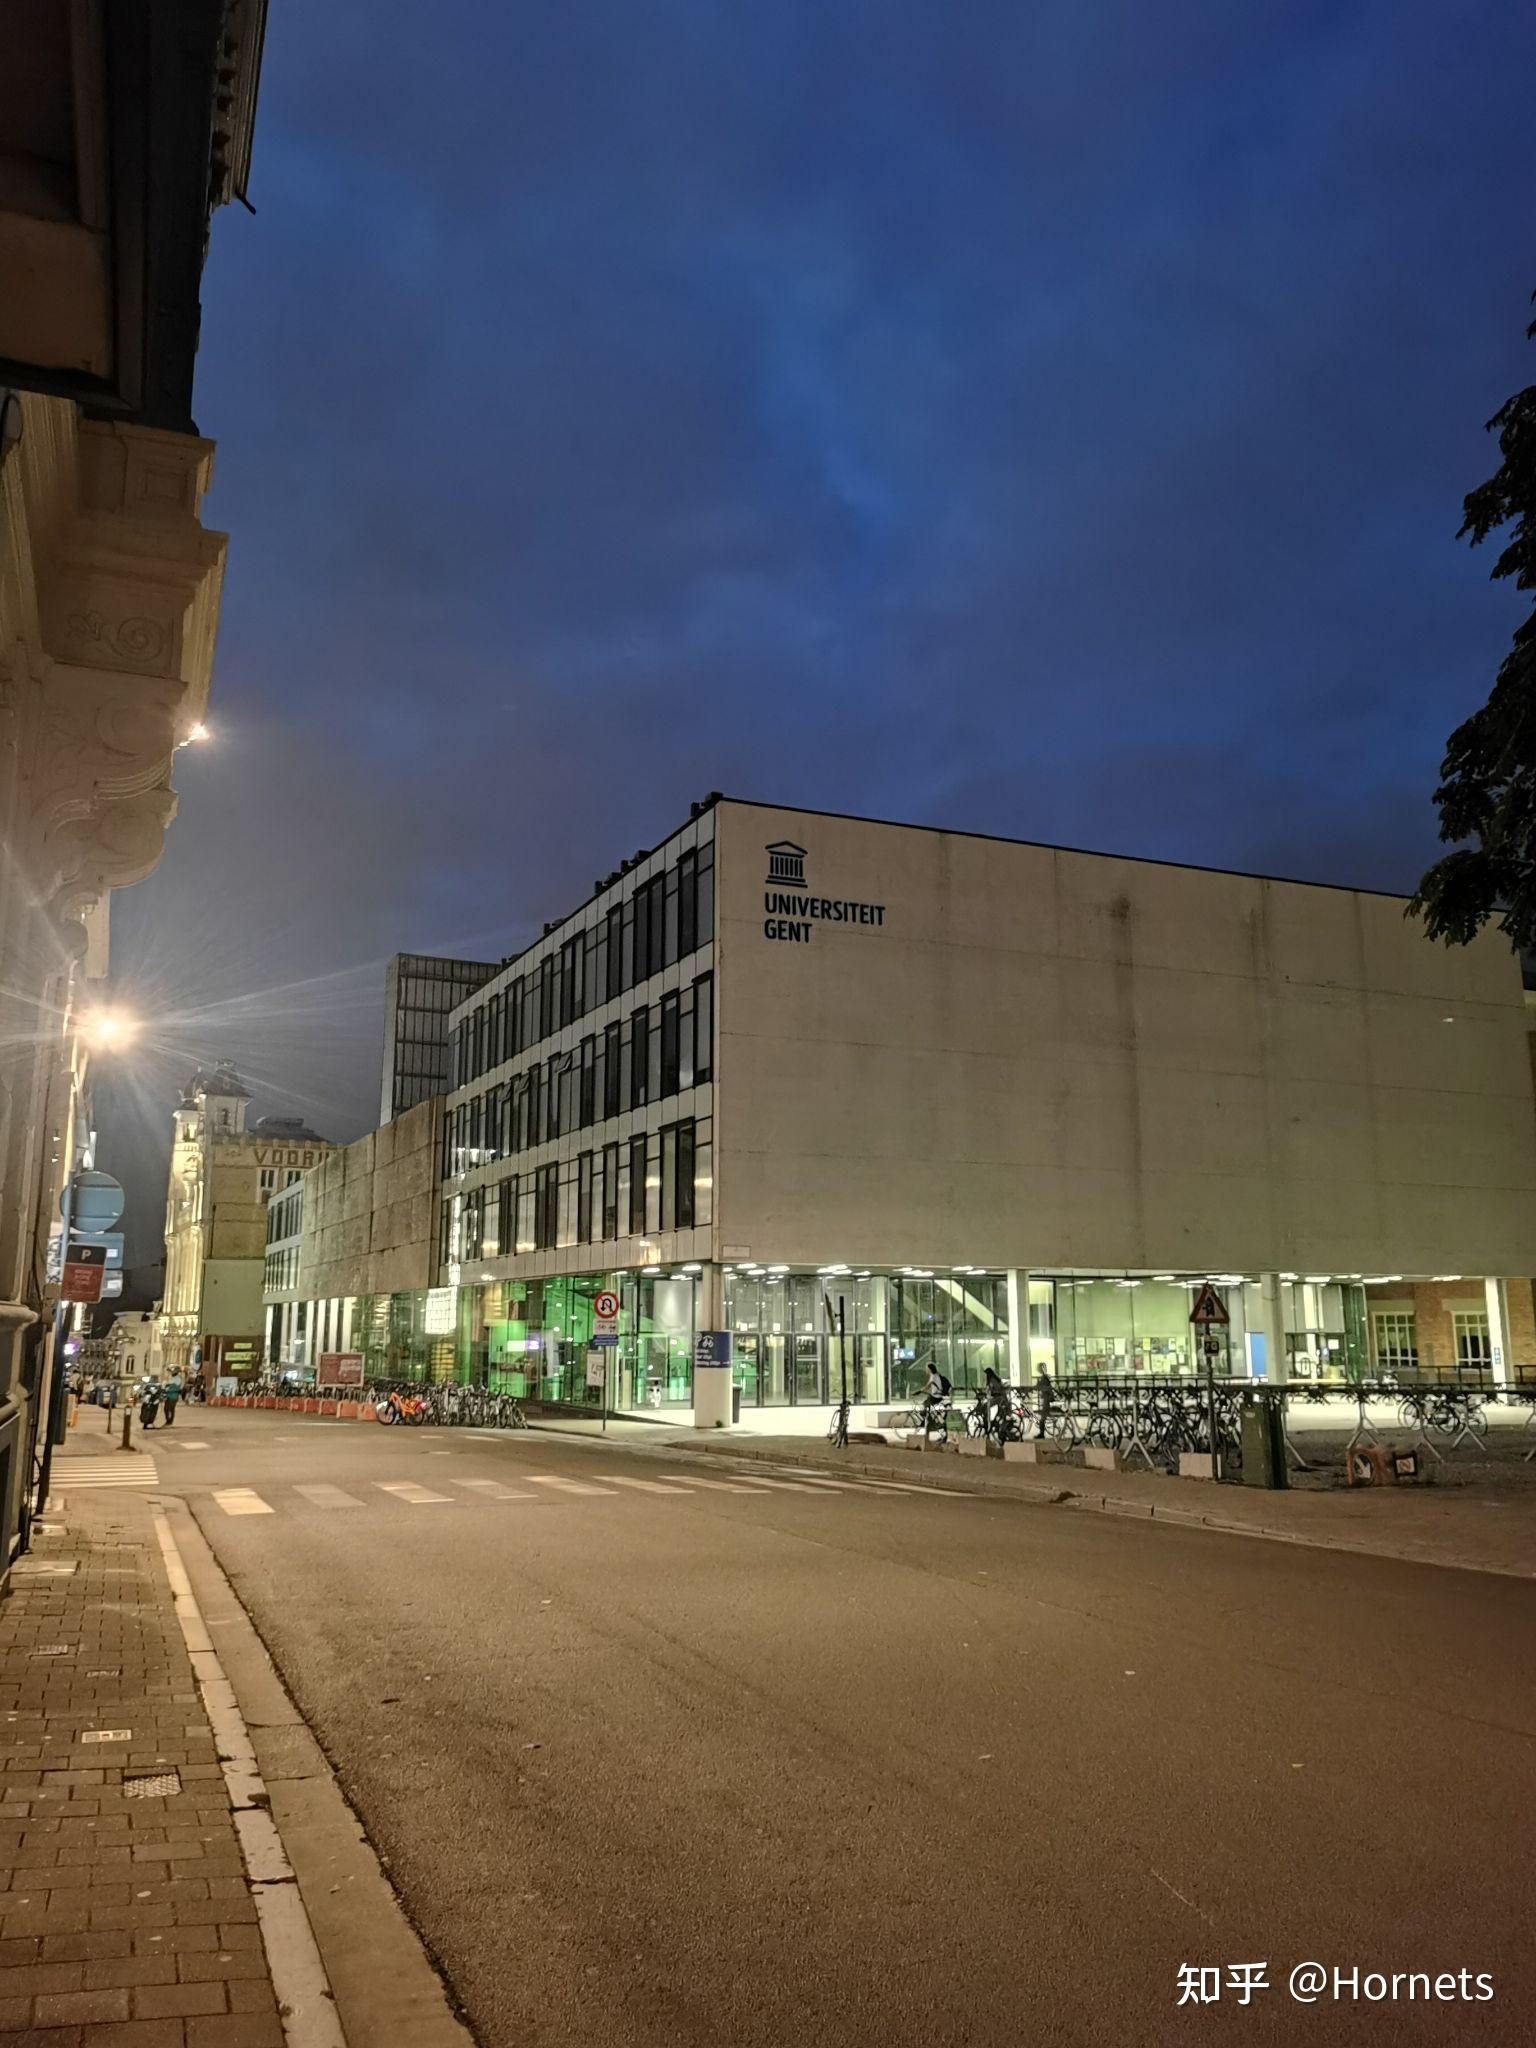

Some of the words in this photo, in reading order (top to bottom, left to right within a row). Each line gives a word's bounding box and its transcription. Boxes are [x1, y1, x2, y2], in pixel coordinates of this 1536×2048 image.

[765, 892, 886, 926] UNIVERSITEIT
[764, 918, 813, 943] GENT
[81, 1249, 93, 1260] P
